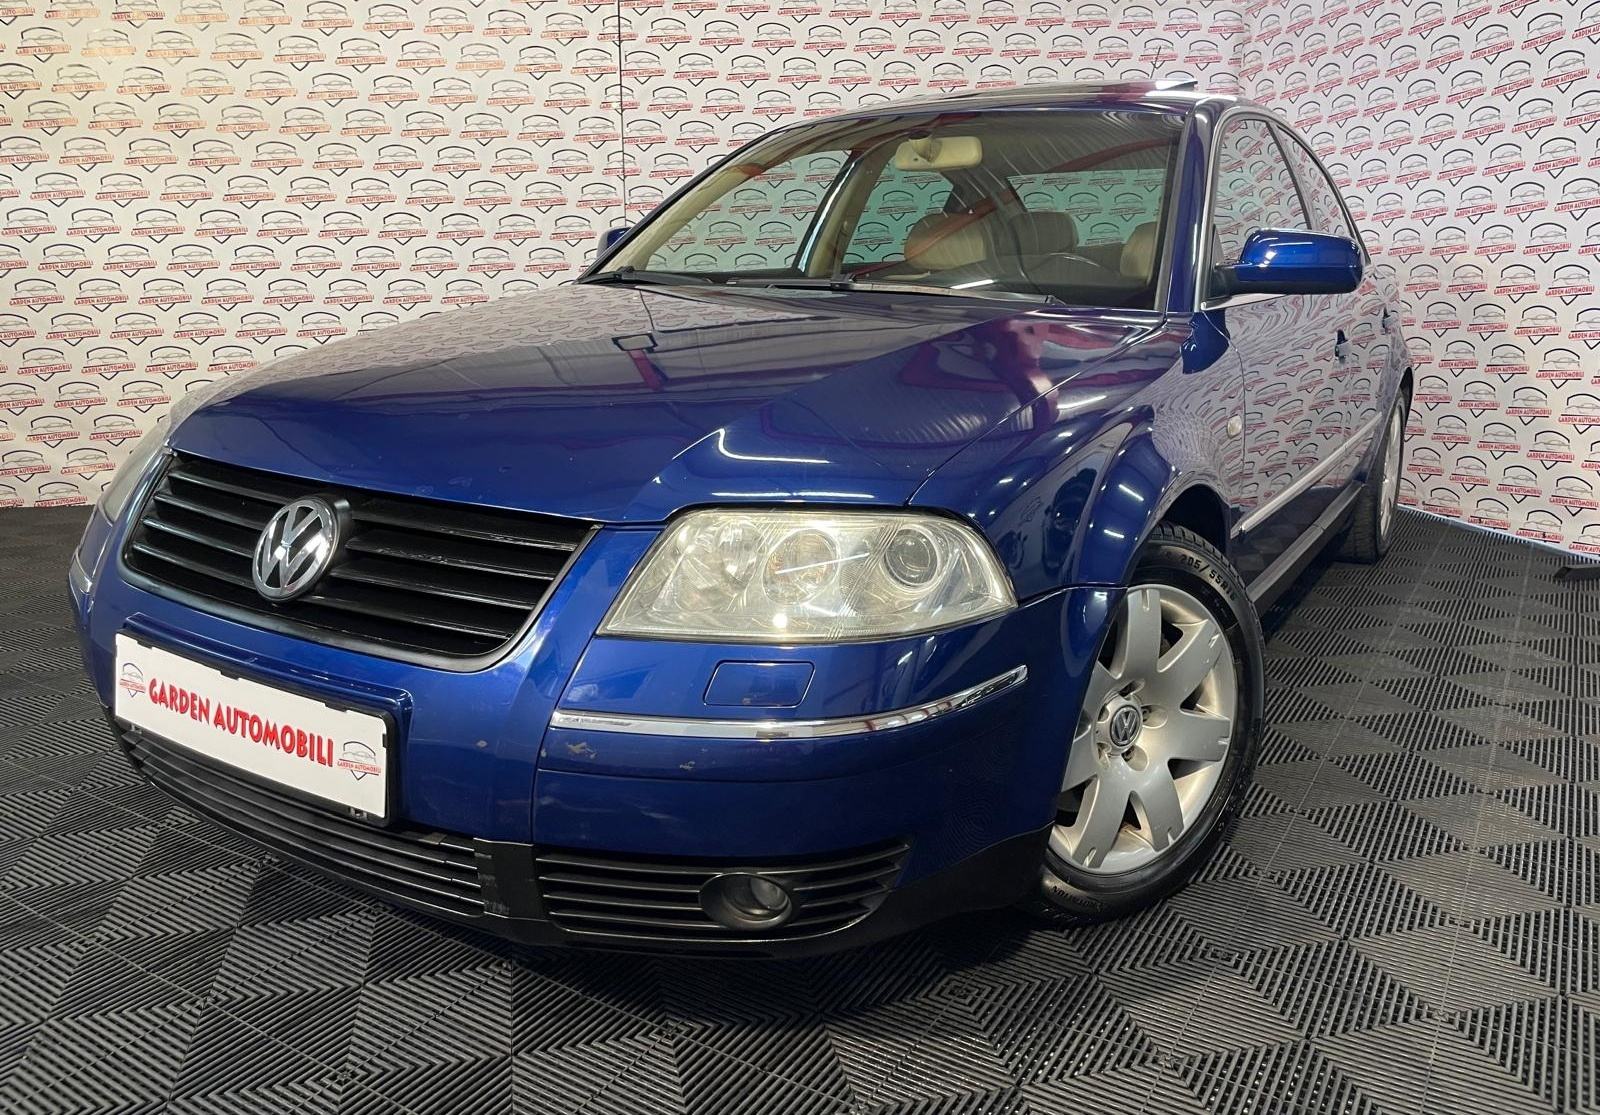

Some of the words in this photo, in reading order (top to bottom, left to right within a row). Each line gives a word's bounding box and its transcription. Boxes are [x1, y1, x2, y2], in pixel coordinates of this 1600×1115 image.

[1521, 40, 1537, 50] GARDEN
[1538, 28, 1568, 43] AUTOMOBILI
[1542, 77, 1559, 88] GARDEN
[1560, 67, 1591, 81] AUTOMOBILI
[1491, 86, 1507, 96] GARDEN
[1507, 76, 1536, 90] AUTOMOBILI
[1511, 124, 1528, 133] GARDEN
[1529, 115, 1558, 128] AUTOMOBILI
[1533, 163, 1550, 172] GARDEN
[1551, 155, 1581, 167] AUTOMOBILI
[1504, 206, 1520, 214] GARDEN
[1521, 200, 1549, 210] AUTOMOBILI
[1542, 241, 1572, 251] AUTOMOBILI
[1511, 283, 1540, 291] AUTOMOBILI
[1564, 284, 1595, 293] AUTOMOBILI
[1533, 326, 1562, 334] AUTOMOBILI
[1551, 496, 1568, 504] GARDEN
[1568, 499, 1599, 507] AUTOMOBILI
[149, 678, 210, 725] GARDEN
[213, 703, 334, 767] AUTOMOBILI
